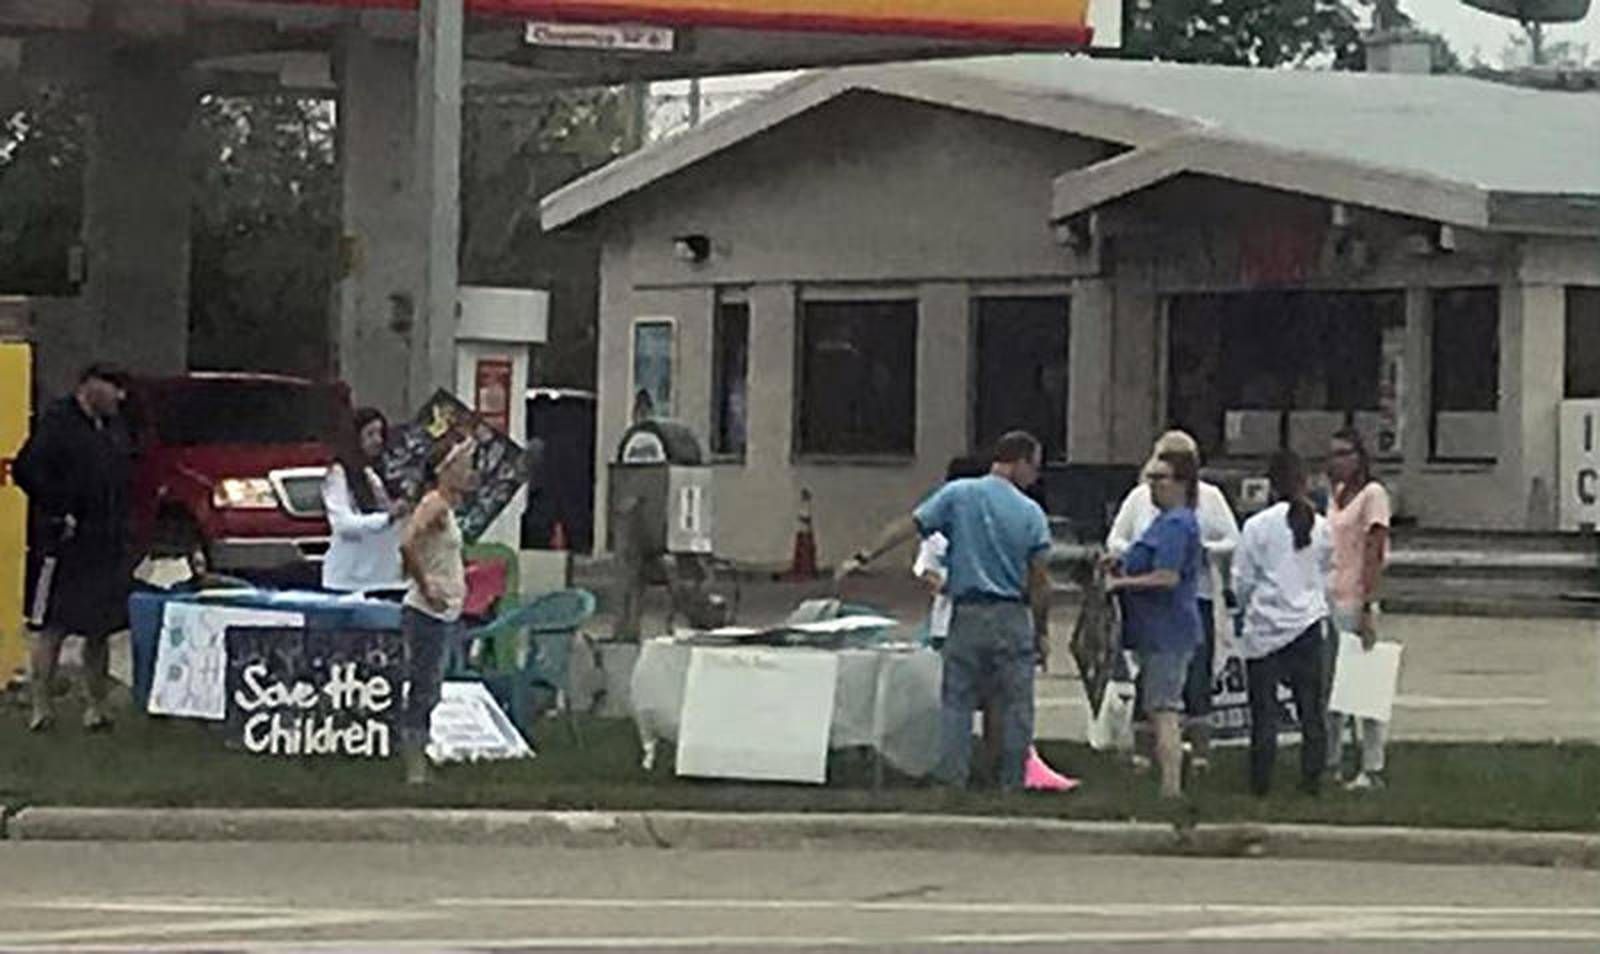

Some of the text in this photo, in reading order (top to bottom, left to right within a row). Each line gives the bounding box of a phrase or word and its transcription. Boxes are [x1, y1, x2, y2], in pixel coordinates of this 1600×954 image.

[234, 661, 392, 712] Save the
[244, 712, 390, 757] Children
